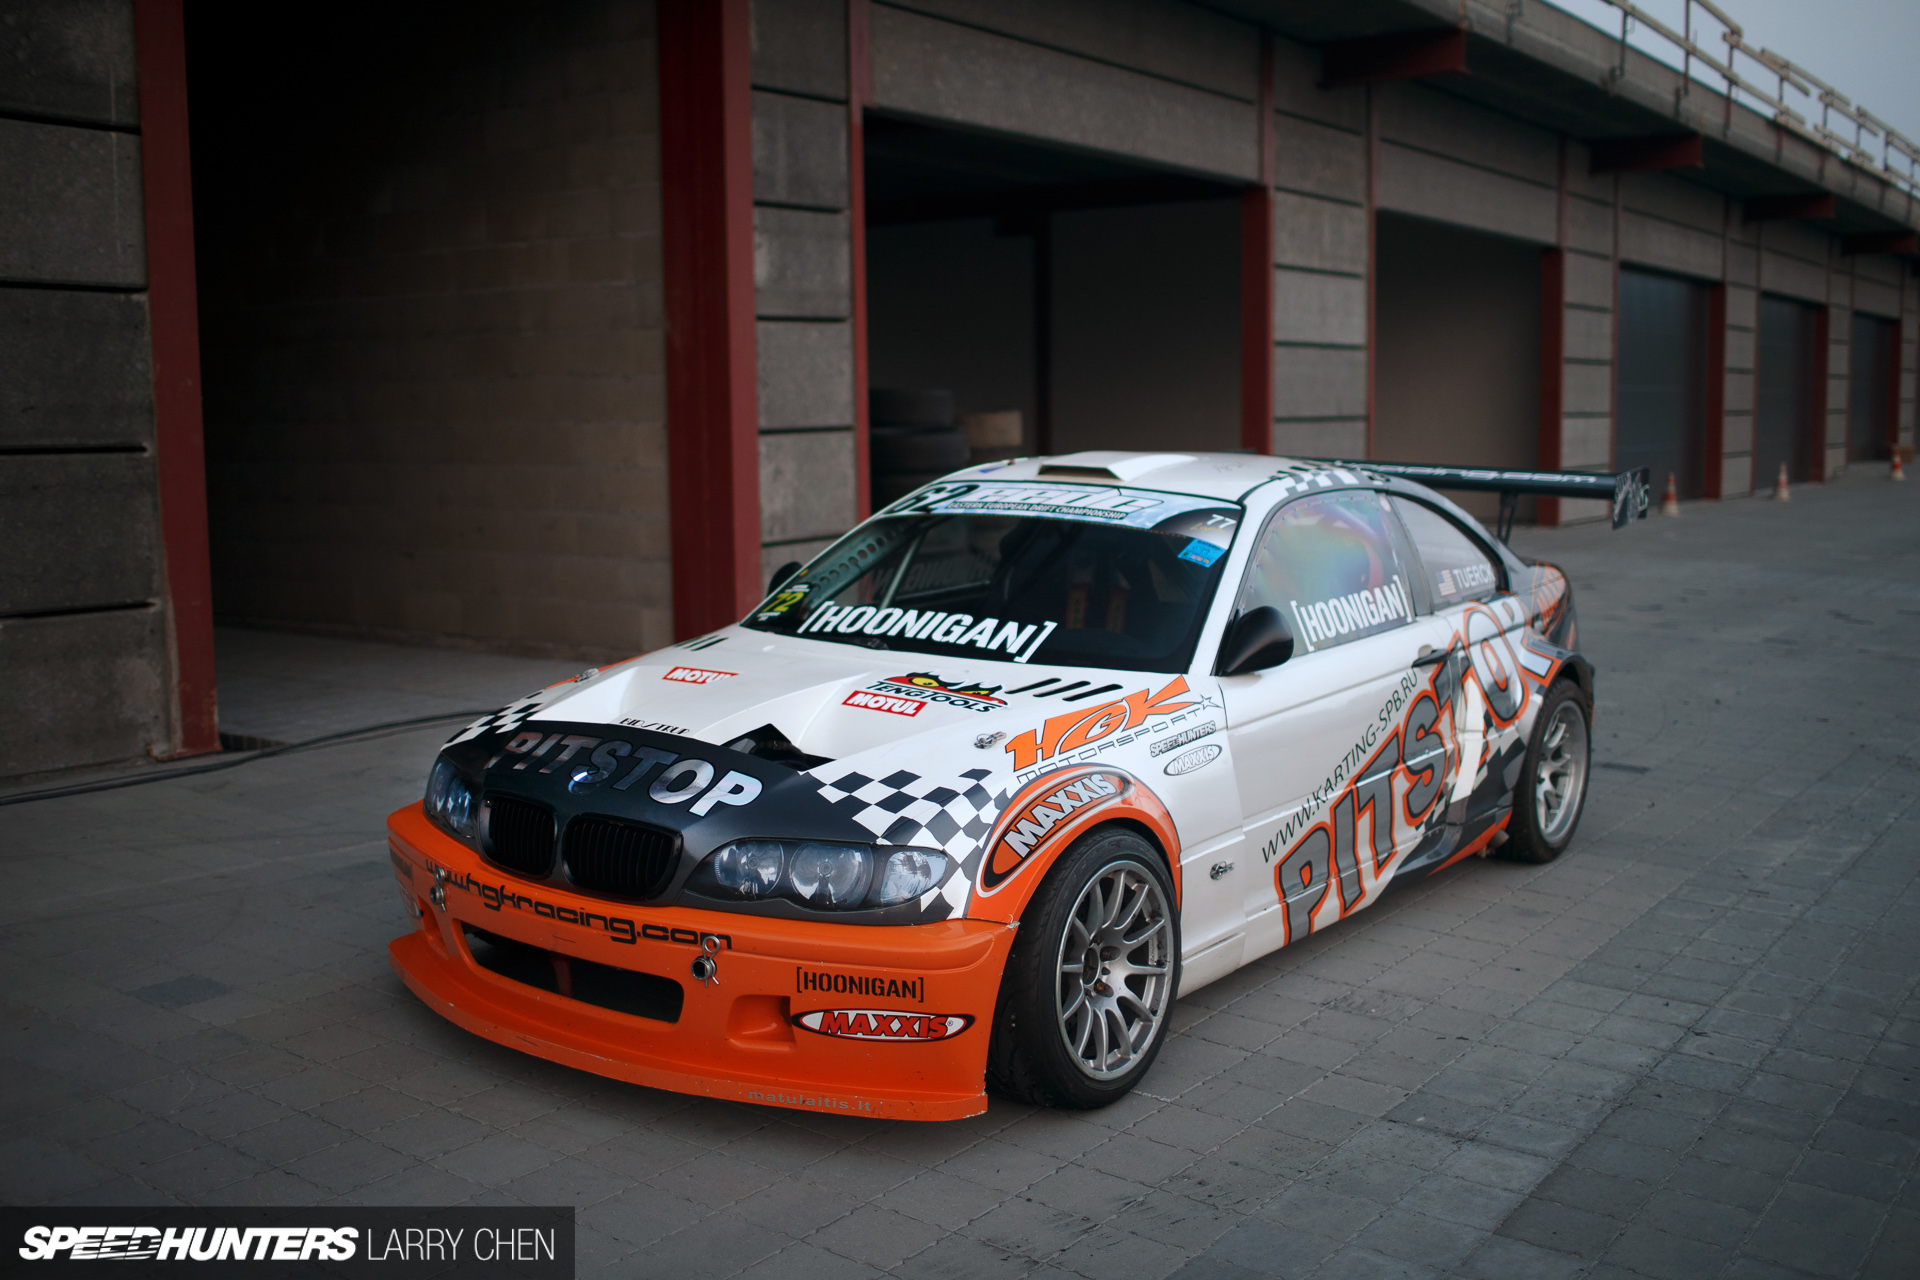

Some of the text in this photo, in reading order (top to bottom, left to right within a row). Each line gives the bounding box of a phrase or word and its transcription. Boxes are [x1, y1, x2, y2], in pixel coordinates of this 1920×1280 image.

[946, 501, 1127, 520] EASTERN EUROPEAN DRIFT CHAMPIONSHIP
[1206, 513, 1237, 529] 77
[1452, 563, 1496, 590] TUERCK
[761, 592, 804, 612] 72
[797, 600, 1058, 664] [HOONIGAN]
[666, 667, 734, 683] MOTU
[846, 692, 921, 715] MOTUL
[1005, 674, 1196, 772] HGK
[483, 731, 763, 817] PITSTOP
[1172, 745, 1215, 775] MAXXIS
[1262, 667, 1419, 863] WWW.KARTING-SPB.RU
[1274, 592, 1562, 946] PITSTOP
[1003, 773, 1118, 859] MAXXIS
[796, 966, 924, 1003] [HOONIGAN]
[818, 1011, 949, 1039] MAXXIS
[748, 1091, 871, 1112] matulaitis.lt
